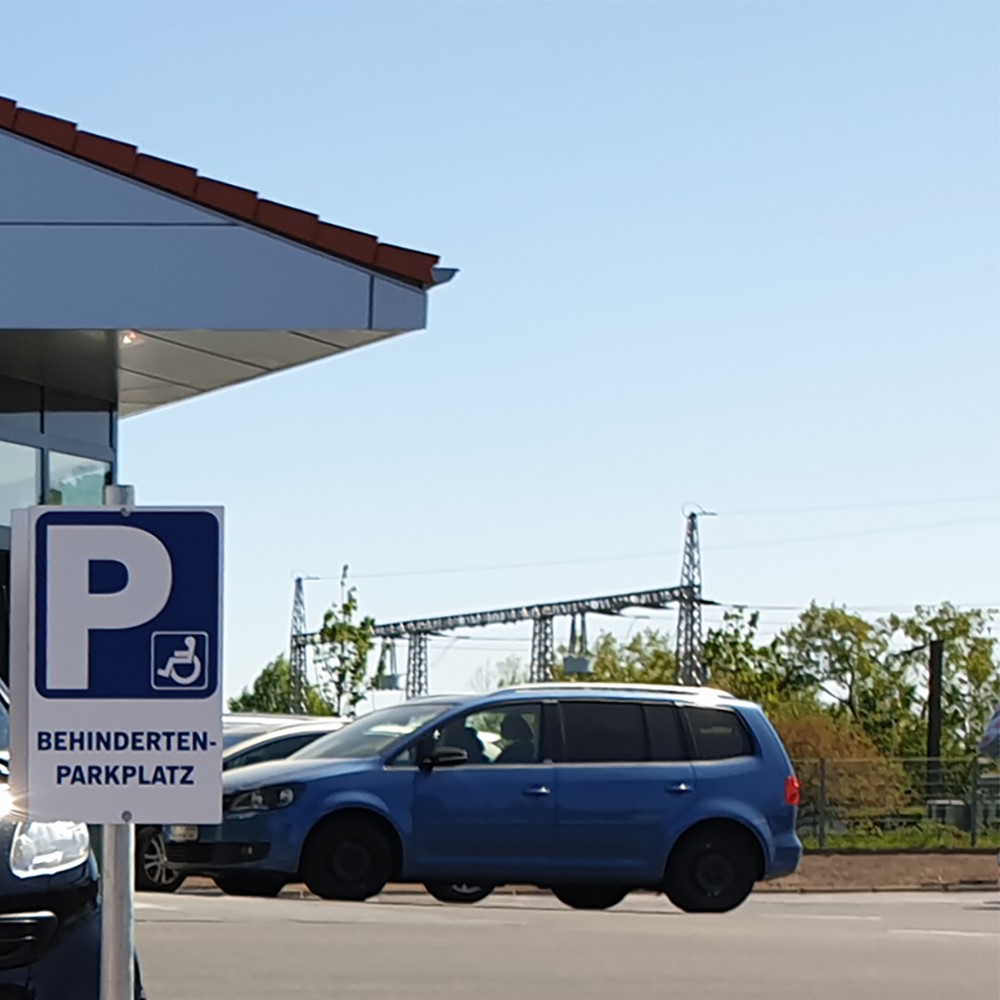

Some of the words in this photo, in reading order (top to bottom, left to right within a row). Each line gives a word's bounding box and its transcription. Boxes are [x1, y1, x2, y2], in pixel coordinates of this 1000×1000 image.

[46, 525, 172, 689] P
[36, 731, 218, 752] BEHINDERTEN-
[56, 765, 195, 786] PARKPLATZ
